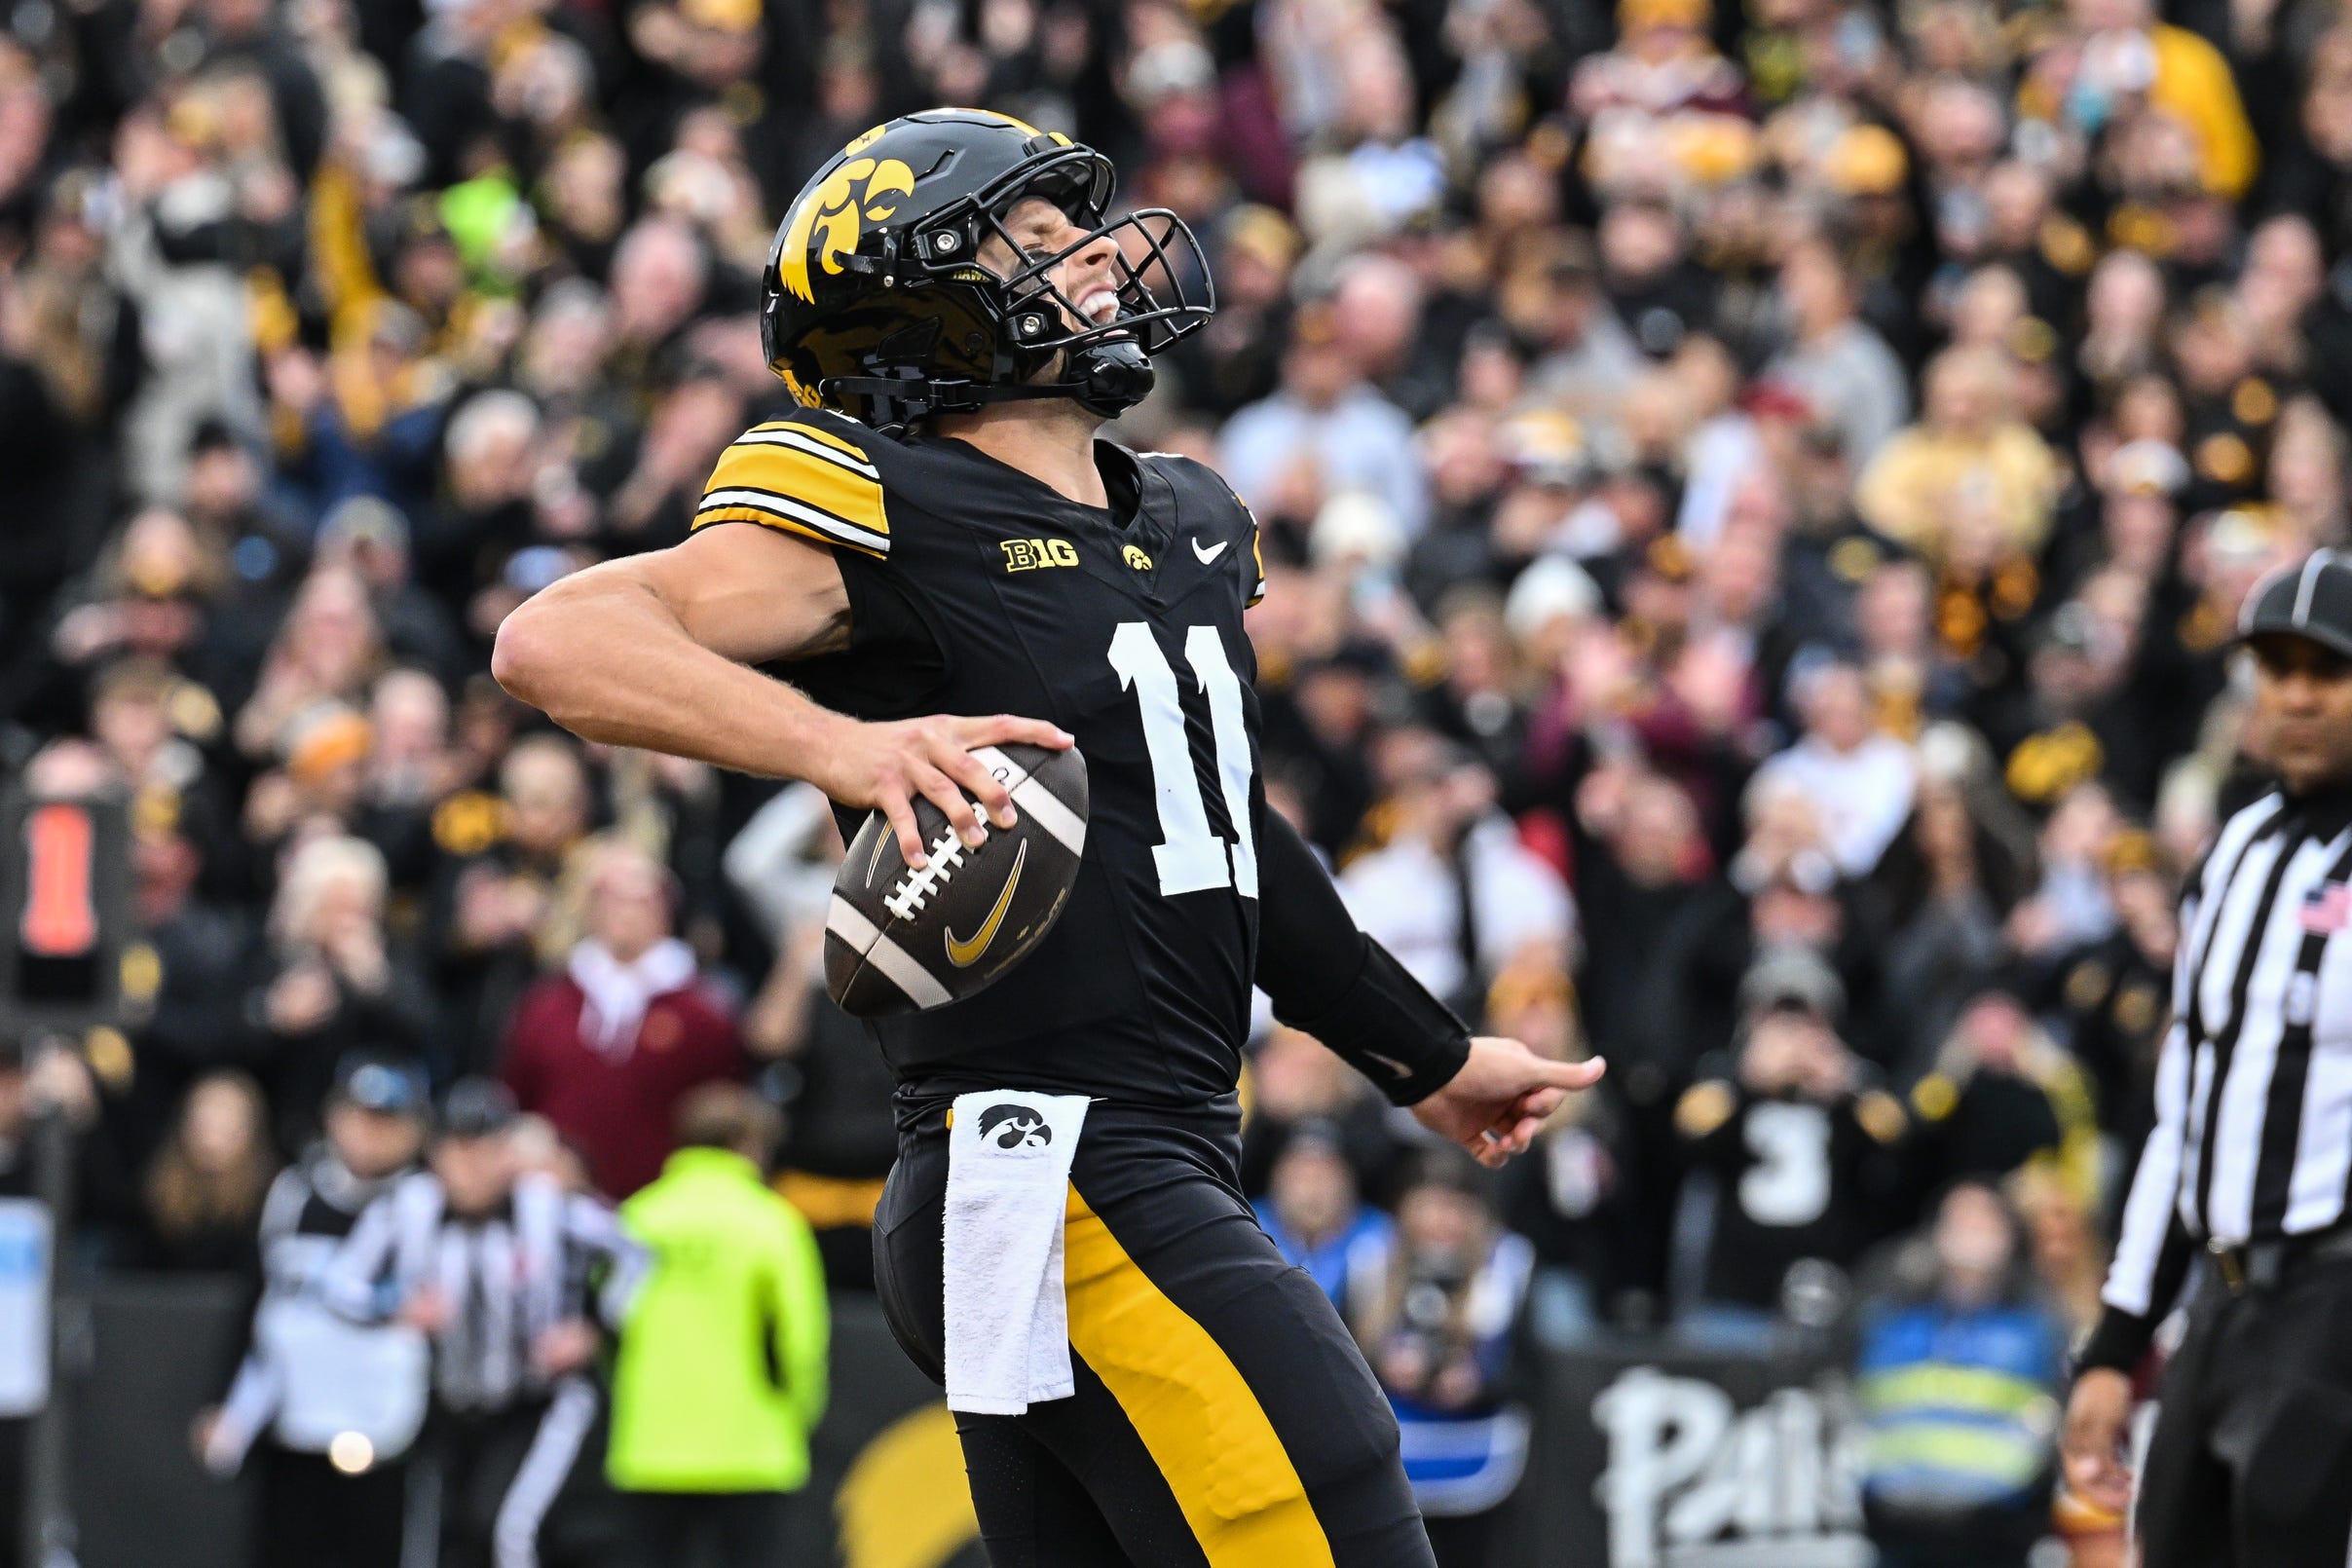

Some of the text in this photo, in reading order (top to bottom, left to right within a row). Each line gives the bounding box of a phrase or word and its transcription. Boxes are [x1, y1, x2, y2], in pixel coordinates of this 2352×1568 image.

[1000, 539, 1079, 573] BIG
[1106, 620, 1259, 900] 11
[21, 803, 97, 956] 1
[1738, 1101, 1832, 1226] 3
